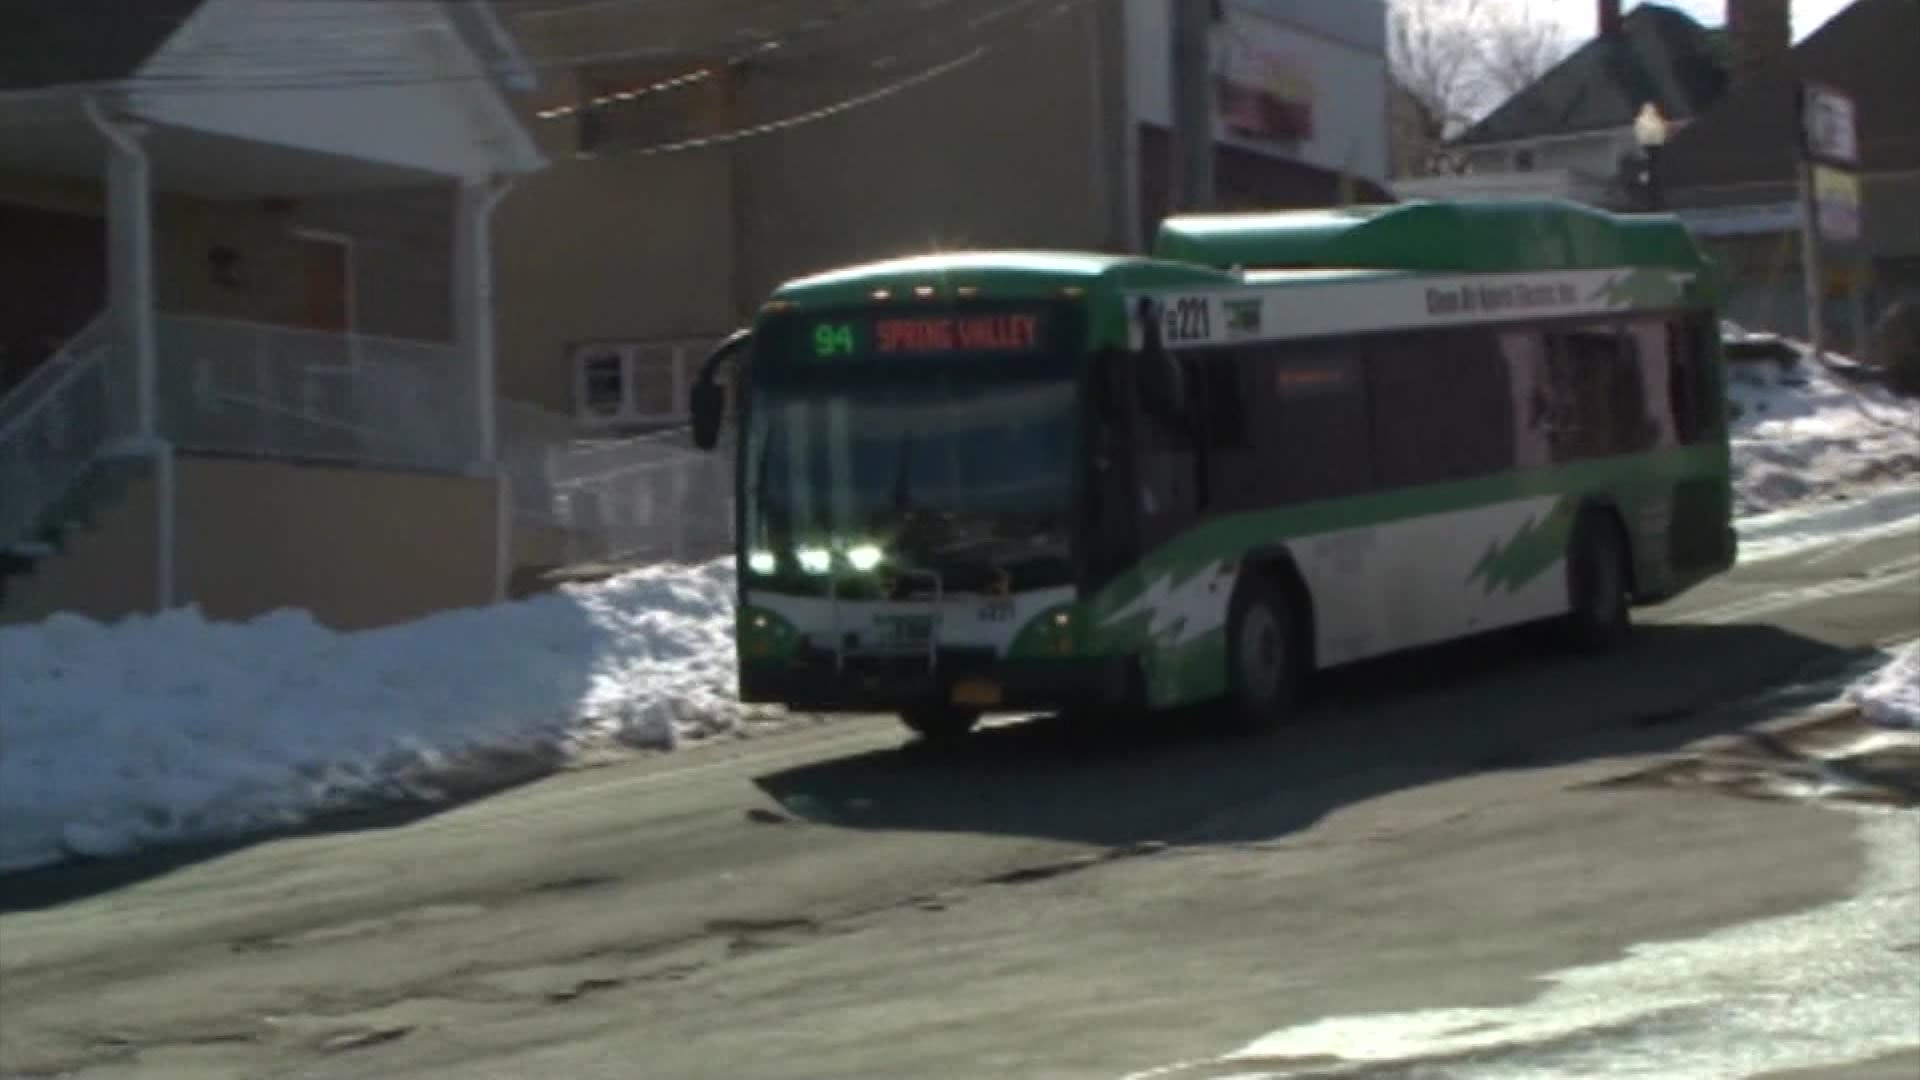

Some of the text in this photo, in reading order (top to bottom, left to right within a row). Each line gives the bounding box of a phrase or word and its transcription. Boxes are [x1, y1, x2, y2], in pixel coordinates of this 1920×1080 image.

[815, 314, 1037, 356] 94 SPRING VALLEY
